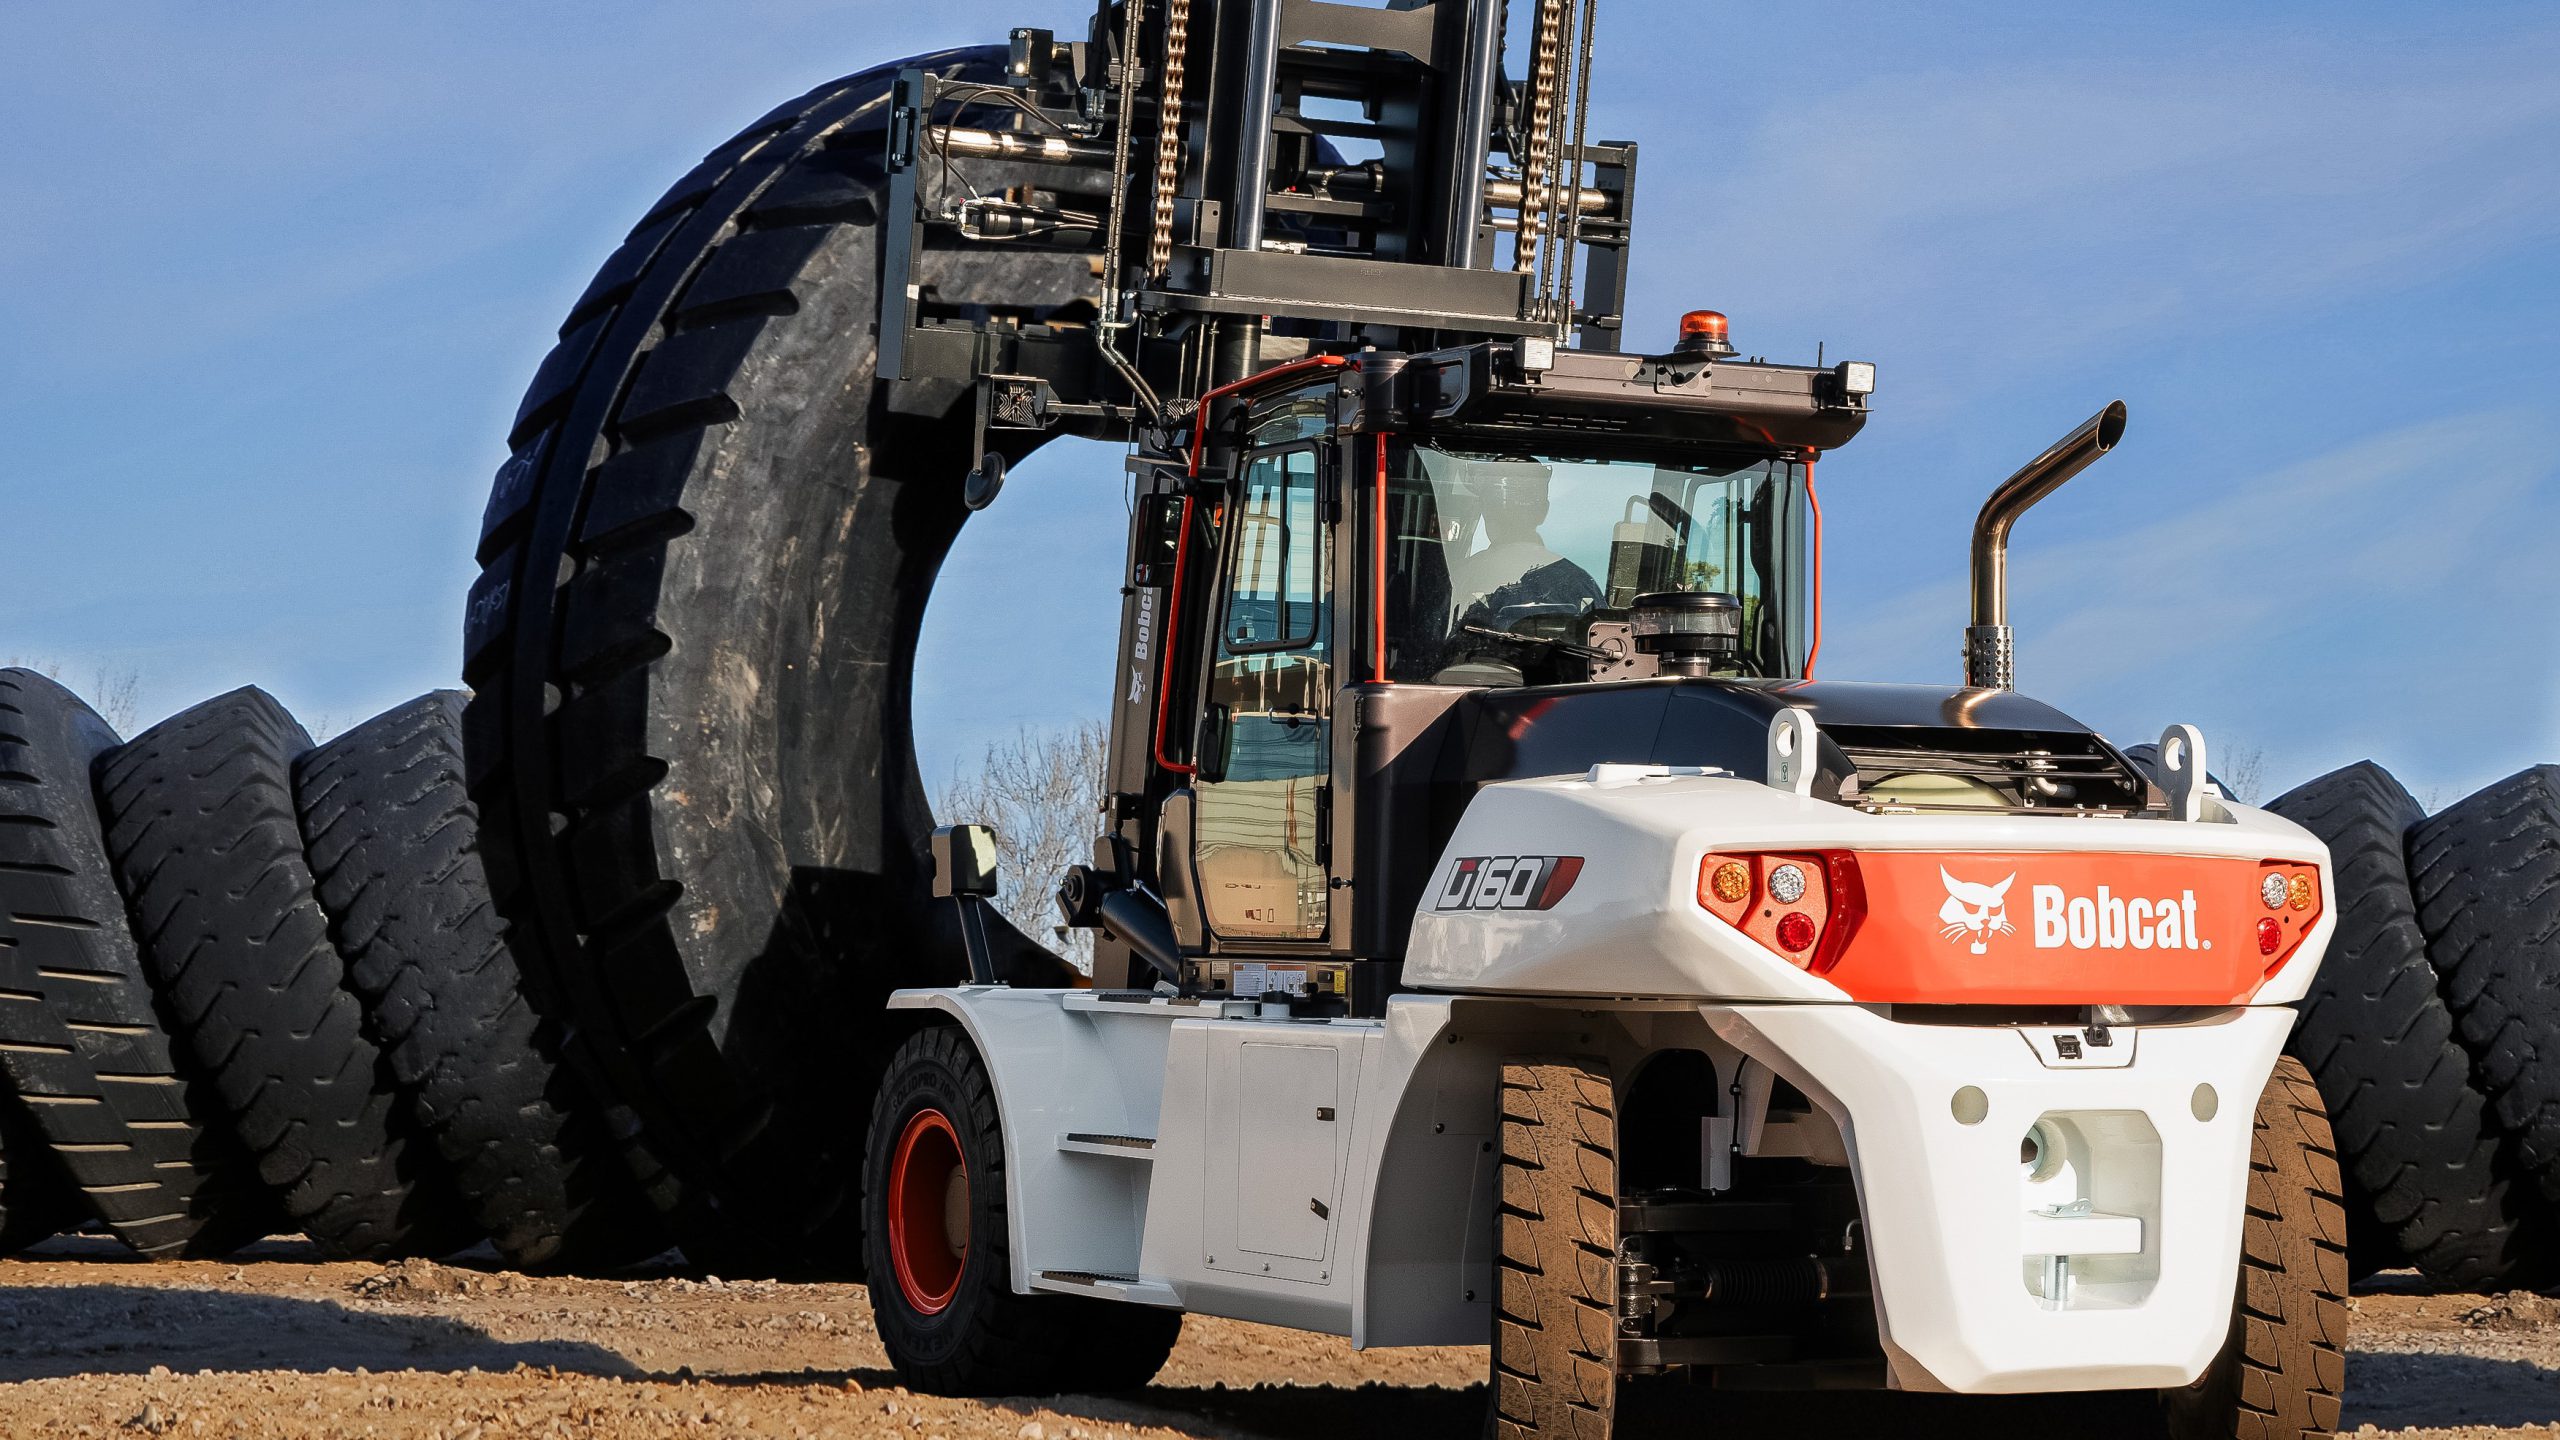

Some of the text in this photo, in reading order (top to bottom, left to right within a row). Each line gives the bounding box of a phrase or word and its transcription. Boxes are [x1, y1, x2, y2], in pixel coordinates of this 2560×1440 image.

[1437, 857, 1544, 909] D160
[2032, 884, 2199, 950] Bobcat
[892, 1072, 956, 1113] SOLIDPRO 700
